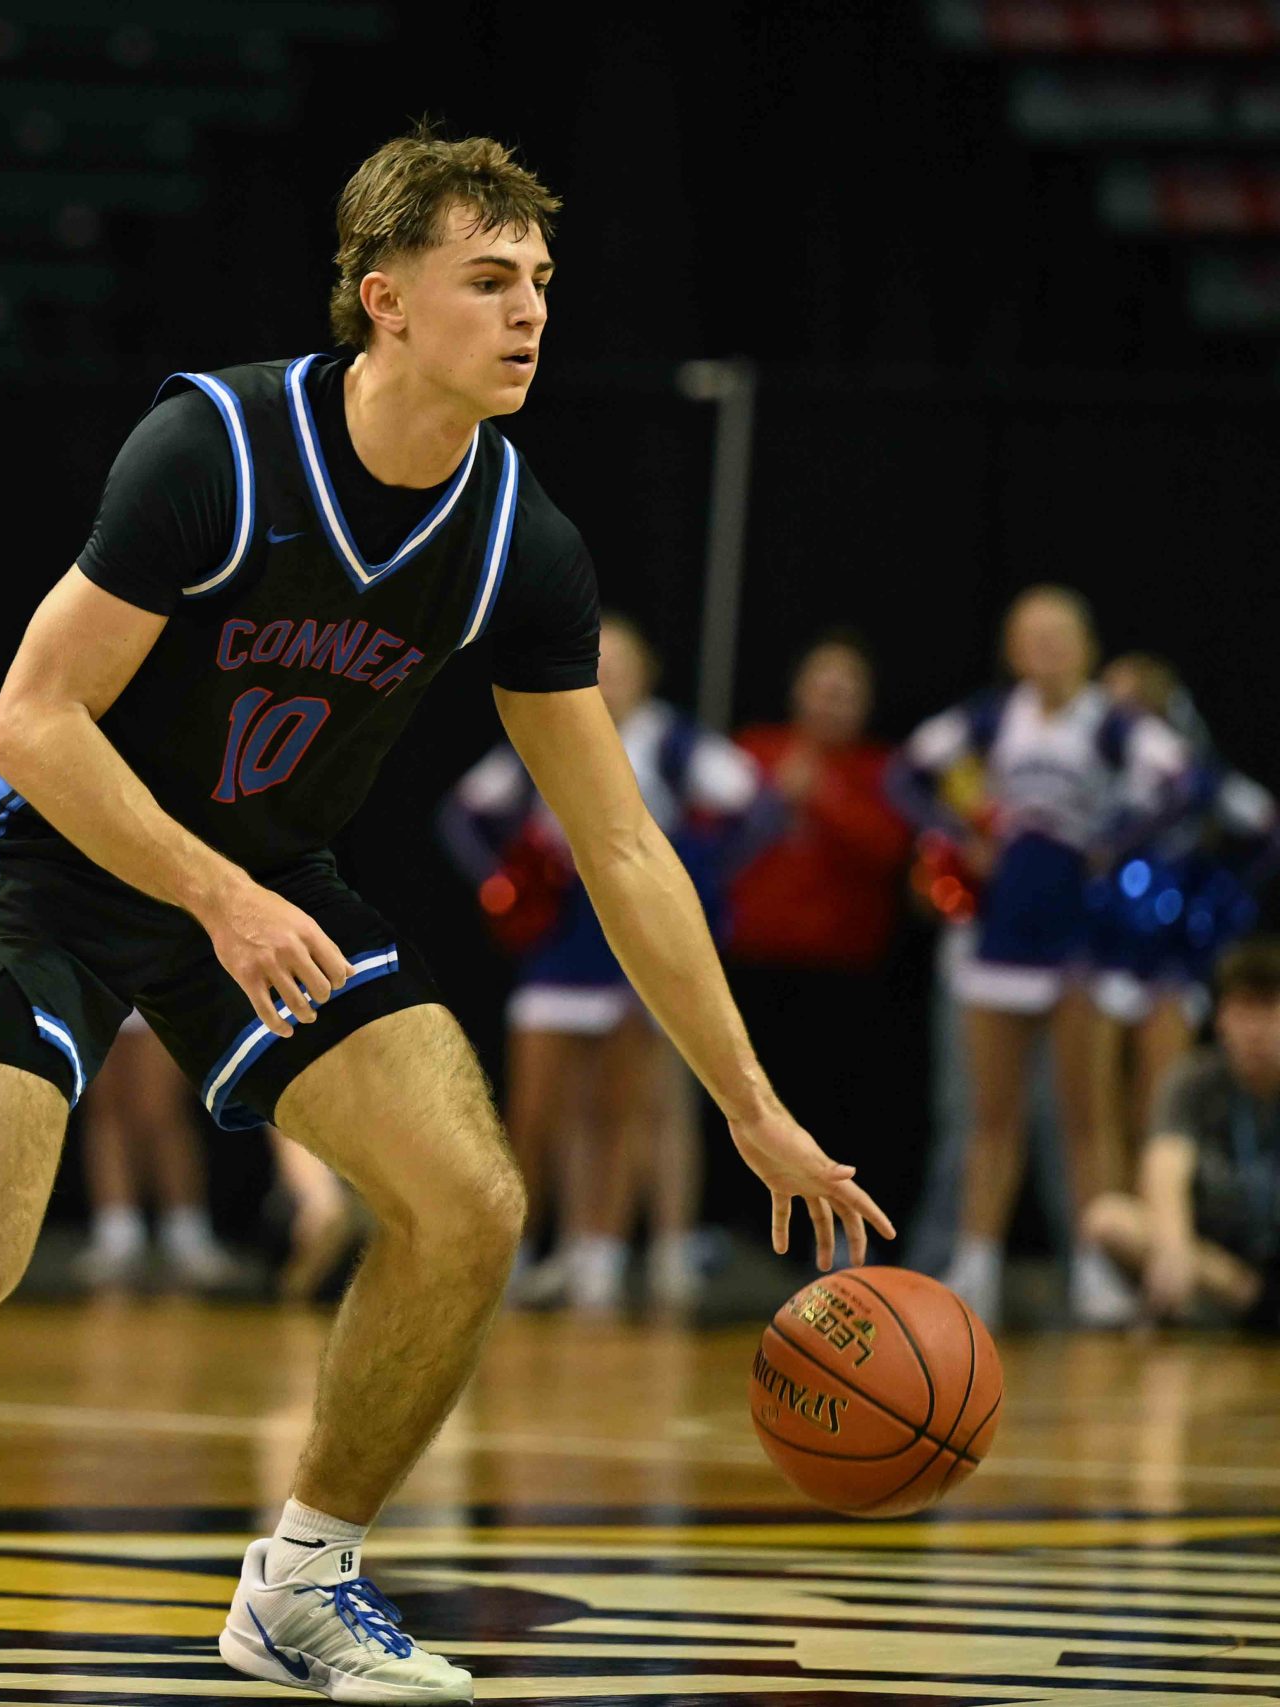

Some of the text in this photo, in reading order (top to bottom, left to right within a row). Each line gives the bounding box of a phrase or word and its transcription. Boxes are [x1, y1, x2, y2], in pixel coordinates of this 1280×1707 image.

[211, 686, 332, 803] 10
[787, 1296, 873, 1369] LEGA
[752, 1346, 849, 1437] SPALDIN
